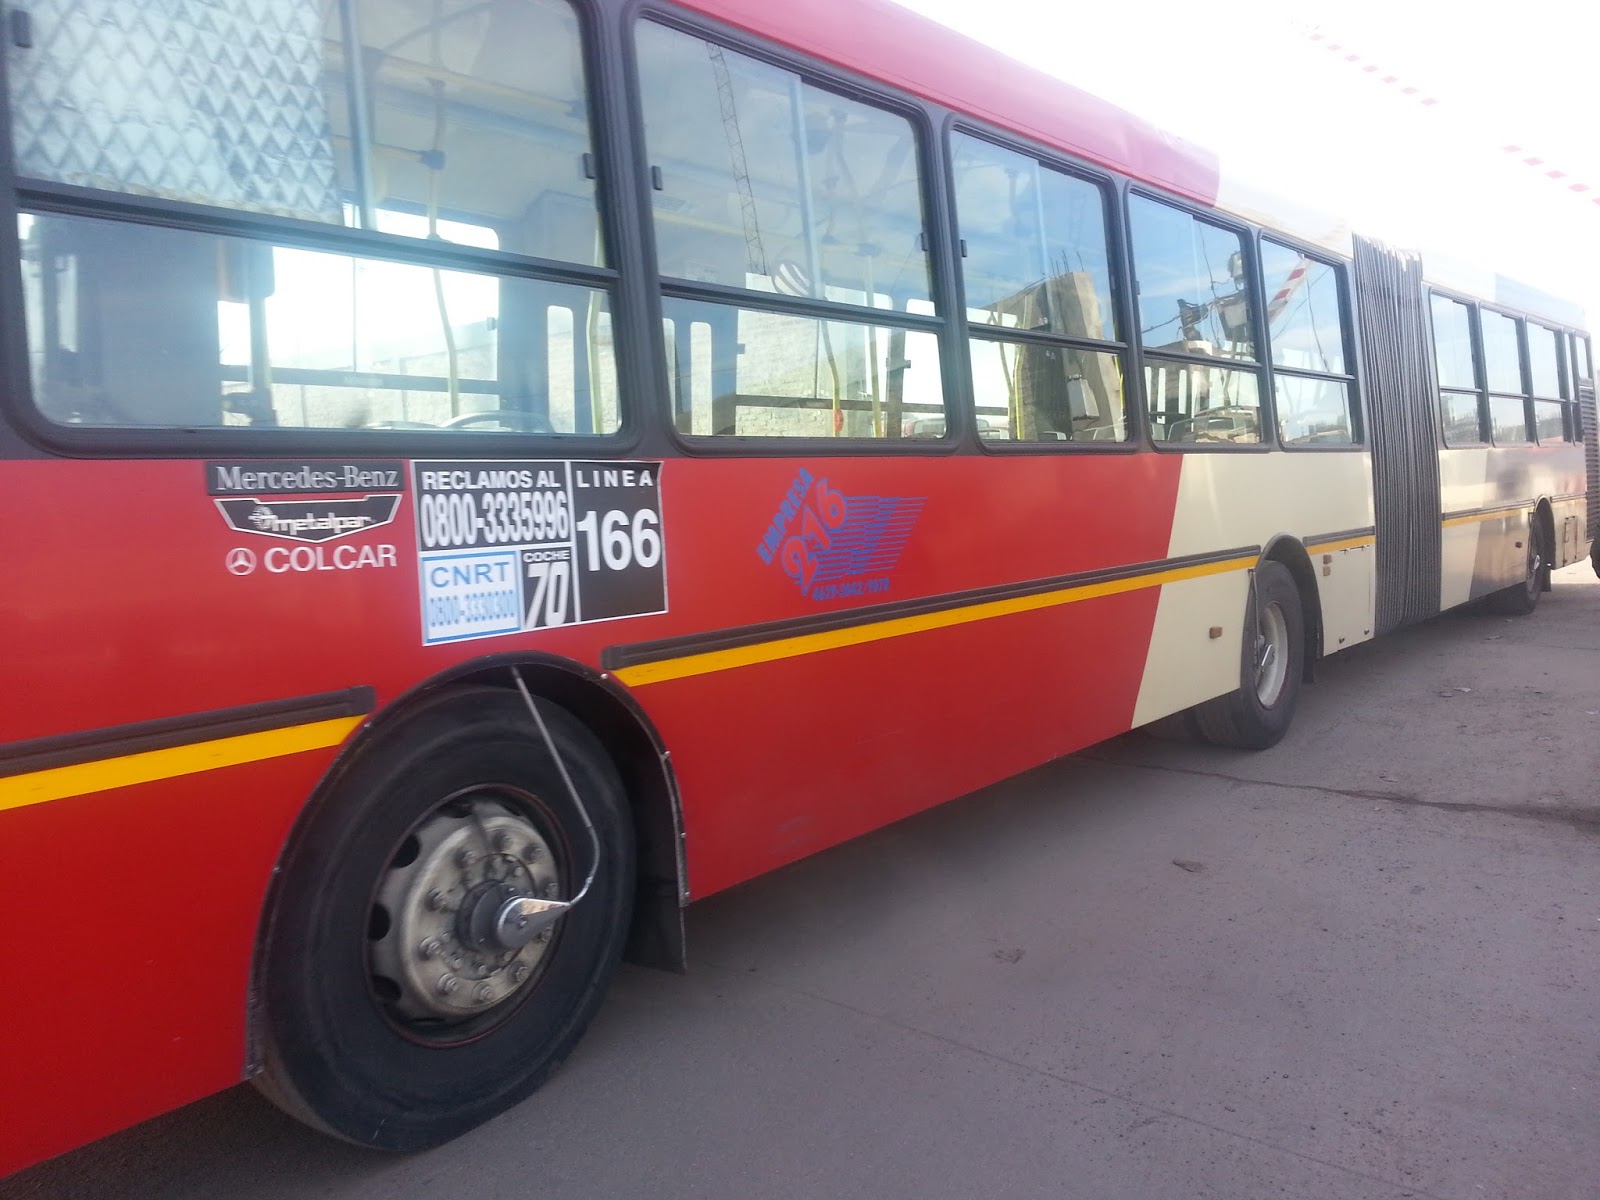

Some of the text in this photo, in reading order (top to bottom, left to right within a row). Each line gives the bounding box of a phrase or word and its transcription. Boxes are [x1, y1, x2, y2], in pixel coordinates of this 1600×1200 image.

[215, 465, 399, 490] Mercedes-Benz
[421, 470, 562, 490] RECLAMOS AL
[576, 469, 654, 488] LINEA
[268, 512, 372, 536] metalpar
[420, 490, 569, 548] 0800-3335996
[757, 467, 814, 565] EMPRESA
[576, 508, 661, 572] 166
[264, 544, 397, 573] COLCAR
[523, 550, 571, 563] COCHE
[430, 561, 510, 588] CNRT
[525, 561, 570, 630] 70
